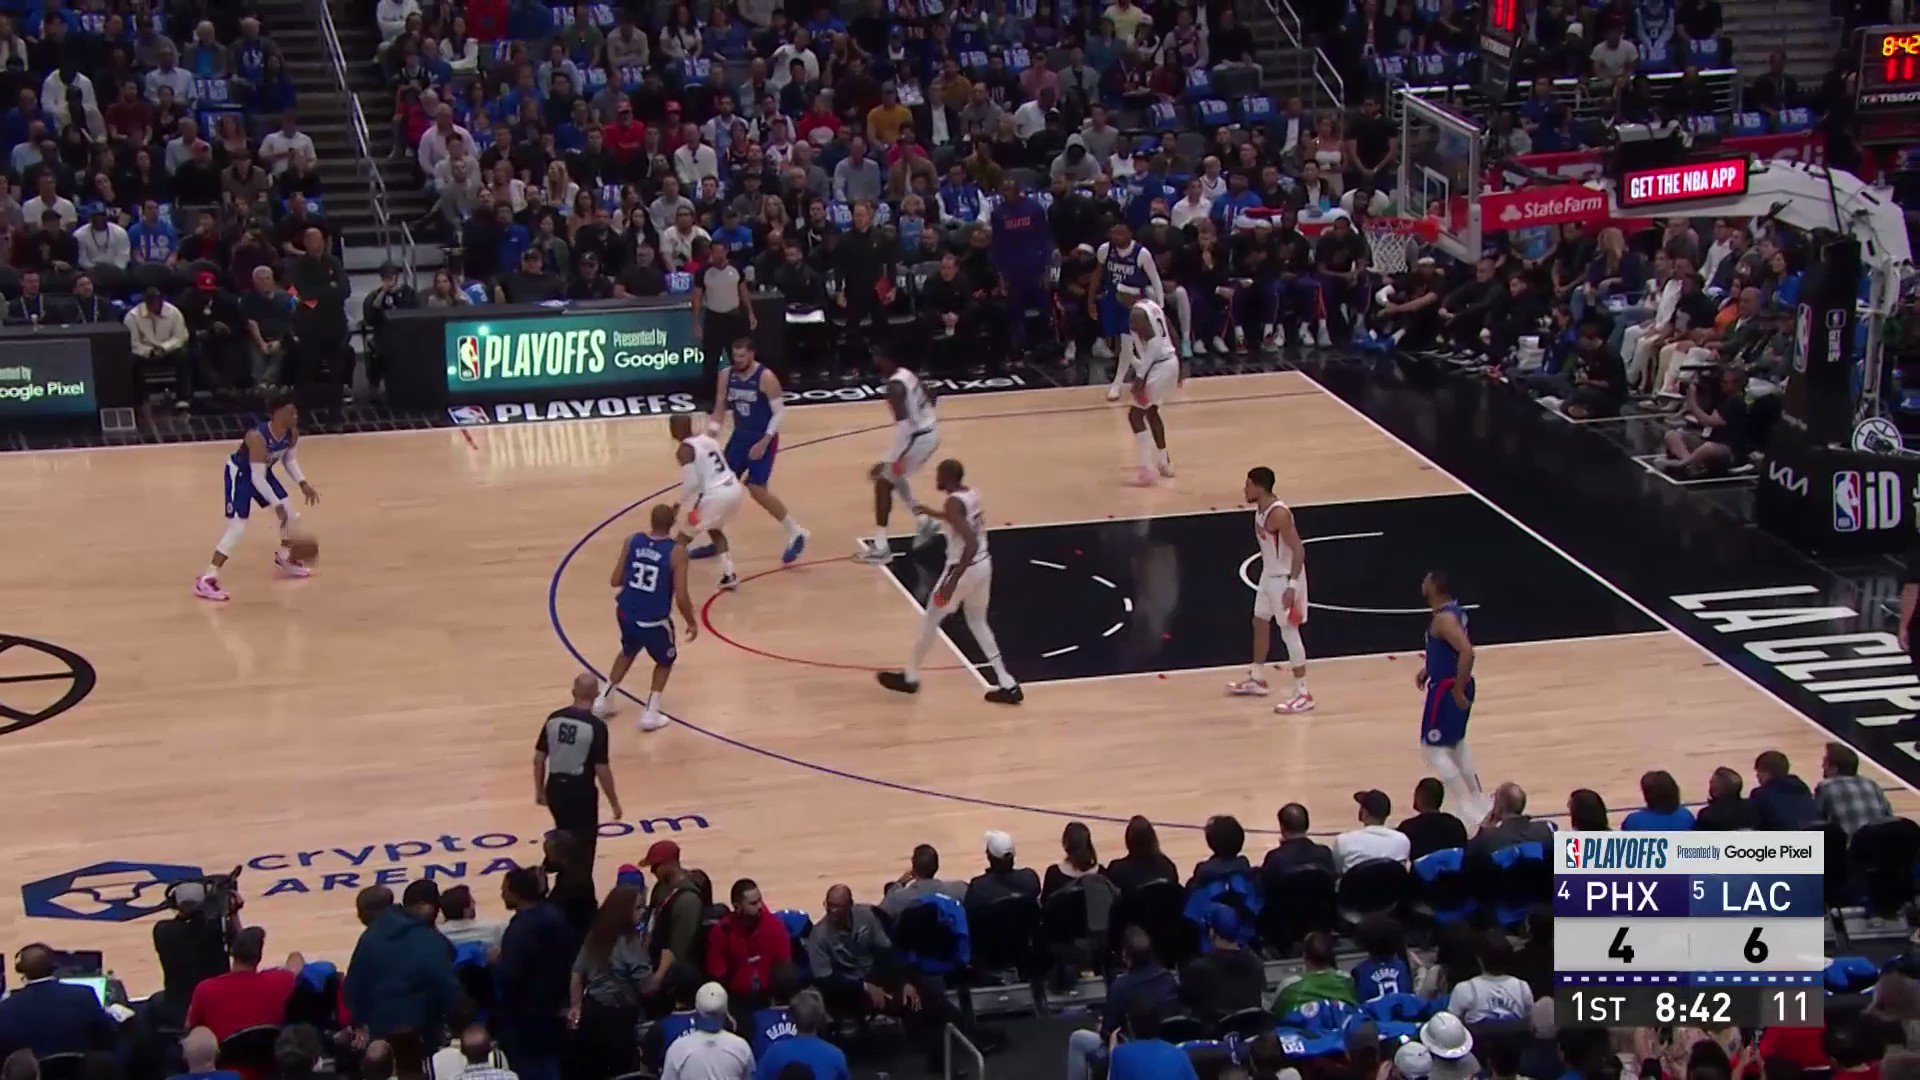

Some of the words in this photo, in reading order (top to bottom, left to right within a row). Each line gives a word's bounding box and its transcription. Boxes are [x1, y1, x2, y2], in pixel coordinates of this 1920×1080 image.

[1882, 34, 1920, 56] 8:42
[1887, 56, 1914, 80] 11
[1631, 176, 1653, 199] GET
[1657, 173, 1680, 196] THE
[1683, 170, 1709, 192] NBA
[1711, 167, 1736, 188] APP
[483, 329, 607, 379] PLAYOFFS
[614, 349, 680, 370] Google
[47, 381, 84, 396] Pixel
[495, 392, 697, 422] PLAYOFFS
[708, 451, 725, 472] 3
[629, 560, 660, 593] 33
[1668, 584, 1859, 634] LA
[1743, 631, 1920, 761] CLIP
[247, 814, 710, 871] crypto.om
[261, 856, 520, 897] ARENA
